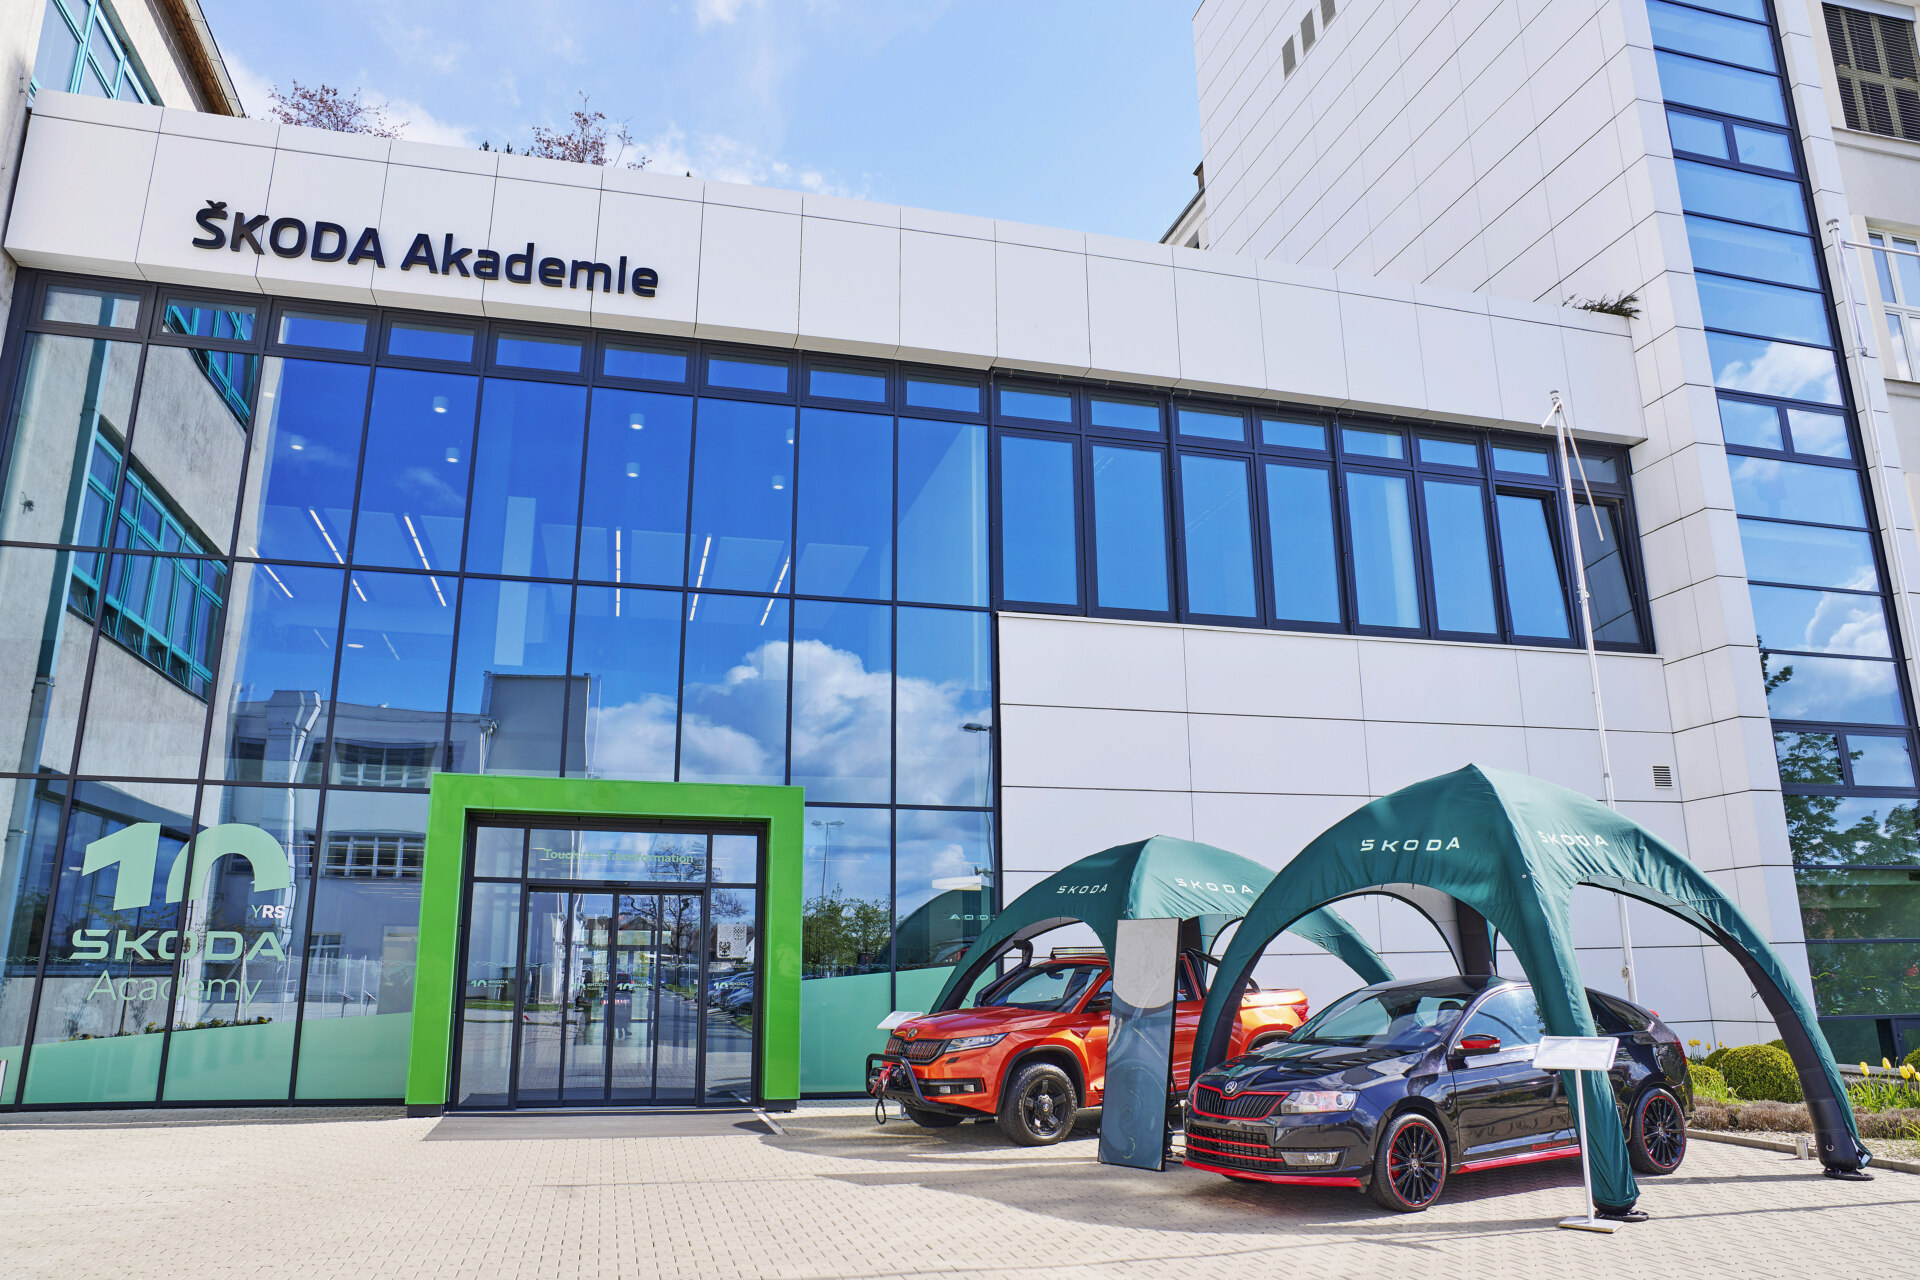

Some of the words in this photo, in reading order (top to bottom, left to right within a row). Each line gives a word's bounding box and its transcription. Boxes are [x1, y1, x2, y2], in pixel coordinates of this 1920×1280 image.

[192, 200, 386, 269] ŠKODA
[544, 848, 579, 860] Touch
[583, 851, 602, 861] the
[606, 850, 694, 864] Transformation
[251, 904, 287, 919] YRS
[87, 970, 263, 1008] Academy
